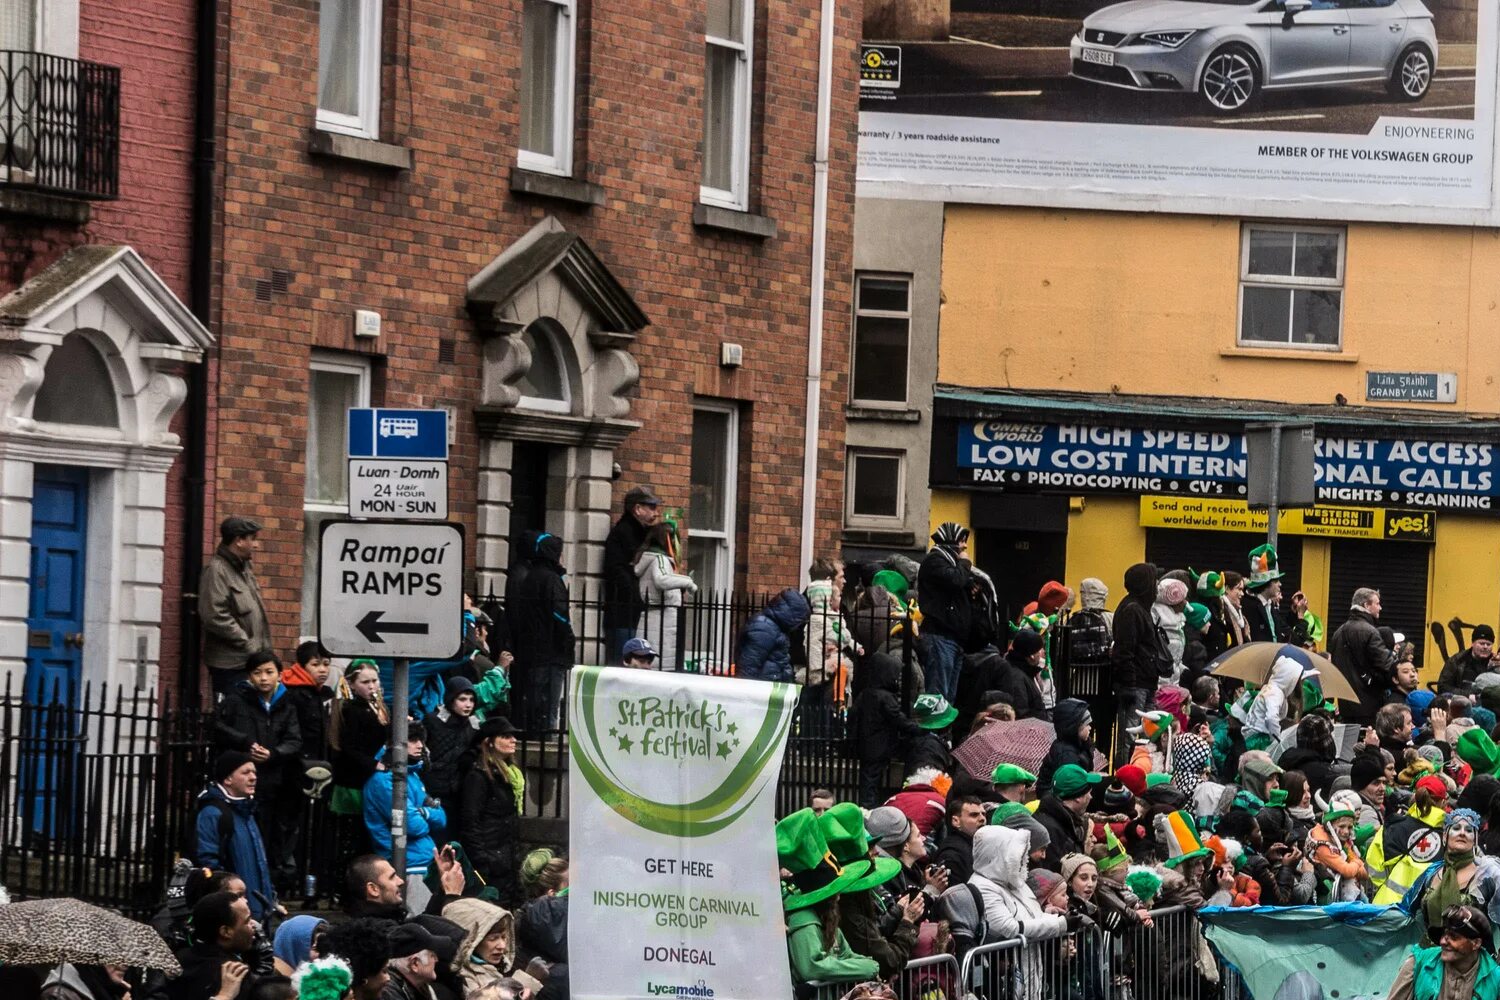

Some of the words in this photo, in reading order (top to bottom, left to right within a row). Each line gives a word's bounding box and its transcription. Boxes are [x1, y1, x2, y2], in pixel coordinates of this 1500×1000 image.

[898, 131, 903, 139] 3
[904, 133, 925, 142] years
[926, 133, 959, 142] roadside
[960, 136, 1000, 144] assistance
[1384, 125, 1475, 140] ENJOYNEERING
[1258, 145, 1308, 158] MEMBER
[1310, 147, 1326, 159] OF
[1328, 148, 1349, 160] THE
[1351, 149, 1430, 163] VOLKSWAGEN
[1432, 152, 1474, 164] GROUP
[1370, 387, 1408, 397] GRANBY
[1411, 389, 1435, 398] LANE
[1444, 382, 1451, 394] 1
[993, 431, 1044, 443] WORLD
[1058, 424, 1131, 447] HIGH
[1142, 429, 1231, 452] SPEED
[1387, 440, 1493, 467] ACCESS
[357, 465, 391, 479] Luan
[400, 466, 440, 480] Domh
[971, 444, 1041, 467] LOW
[1050, 449, 1128, 472] COST
[1399, 468, 1492, 491] CALLS
[374, 484, 392, 498] 24
[396, 483, 418, 492] Uair
[973, 468, 1005, 483] FAX
[1027, 471, 1162, 492] PHOTOCOPYING
[1189, 479, 1223, 494] CV's
[1318, 487, 1383, 502] NIGHTS
[1405, 491, 1491, 509] SCANNING
[360, 500, 395, 513] MON
[406, 501, 436, 514] SUN
[1152, 500, 1177, 512] Send
[1182, 502, 1202, 513] and
[1207, 504, 1245, 515] receive
[1304, 508, 1359, 519] WESTERN
[1163, 514, 1218, 527] worldwide
[1222, 516, 1247, 528] from
[1251, 518, 1271, 529] her
[1320, 517, 1359, 527] UNION
[1389, 513, 1429, 536] yes!
[1306, 527, 1331, 535] MONEY
[1333, 528, 1369, 537] TRANSFER
[340, 538, 451, 568] Rampaí
[342, 570, 442, 597] RAMPS
[644, 858, 677, 874] GET
[681, 860, 714, 878] HERE
[593, 891, 685, 911] INISHOWEN
[688, 896, 760, 917] CARNIVAL
[655, 911, 708, 929] GROUP
[643, 946, 716, 966] DONEGAL
[647, 981, 715, 997] Lycamobile
